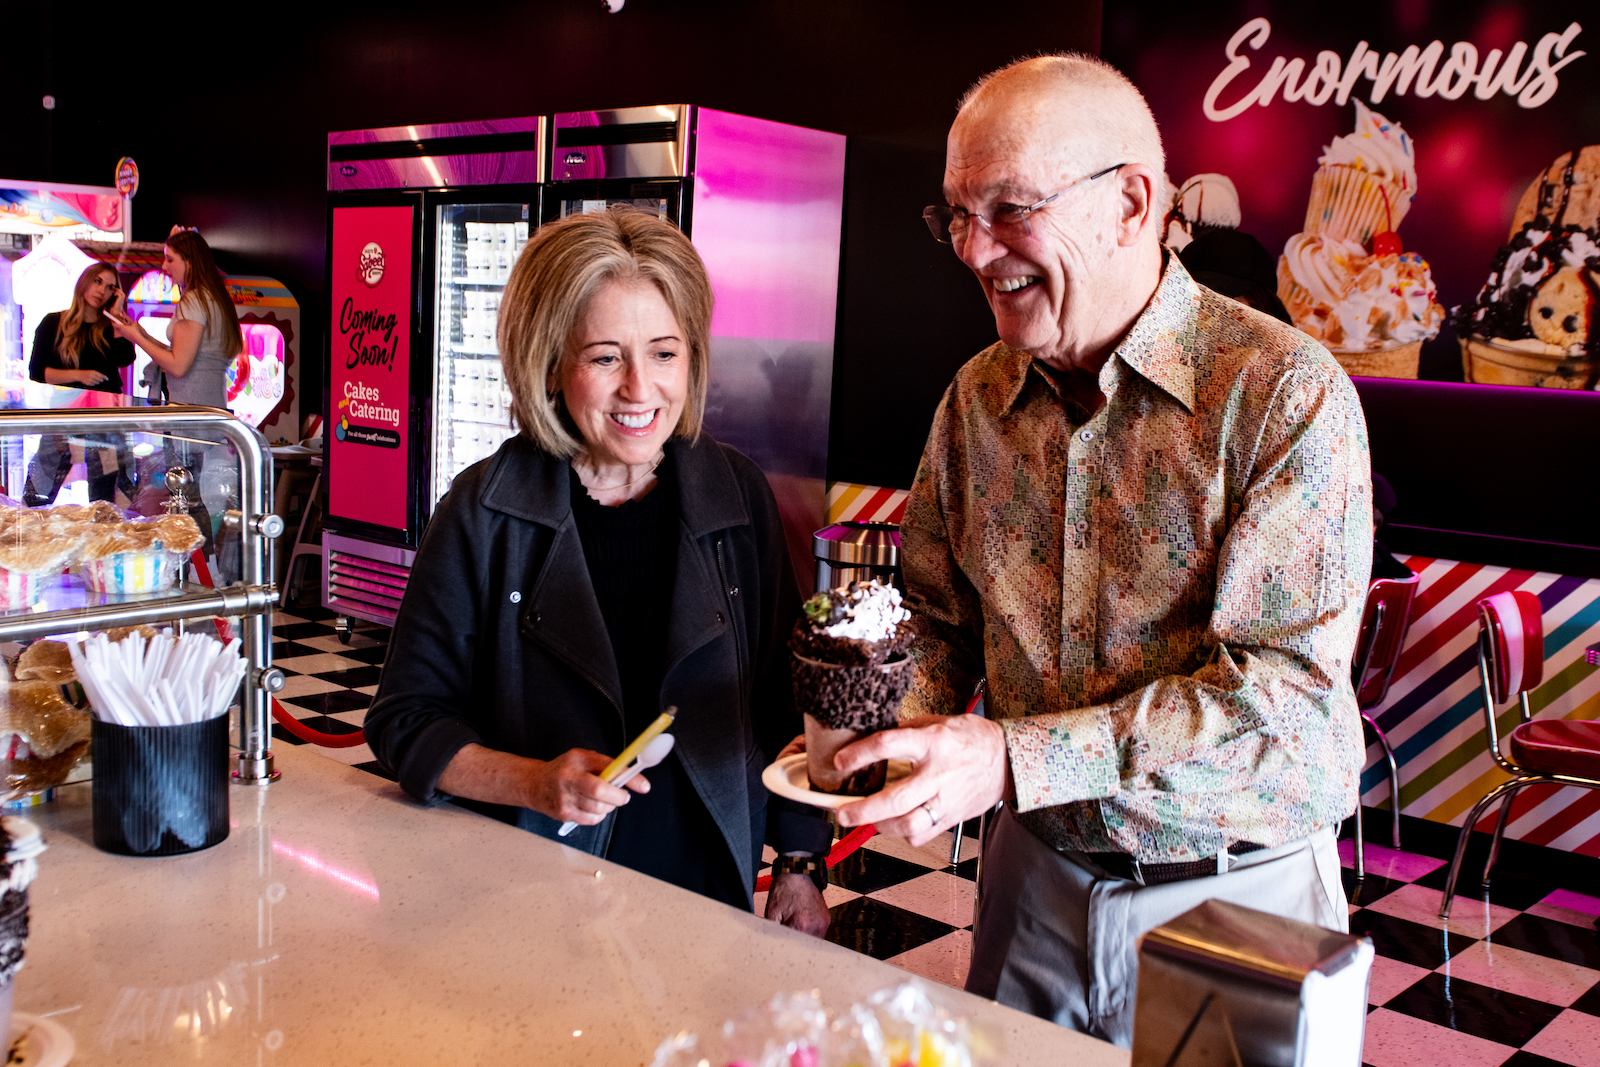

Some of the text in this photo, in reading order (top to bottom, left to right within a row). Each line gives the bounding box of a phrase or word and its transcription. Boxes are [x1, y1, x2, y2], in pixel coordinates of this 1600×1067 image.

[1203, 17, 1587, 122] Enormous
[340, 297, 398, 343] Coming
[346, 330, 398, 372] Soon!
[344, 381, 379, 401] Cakes
[350, 400, 400, 427] Catering
